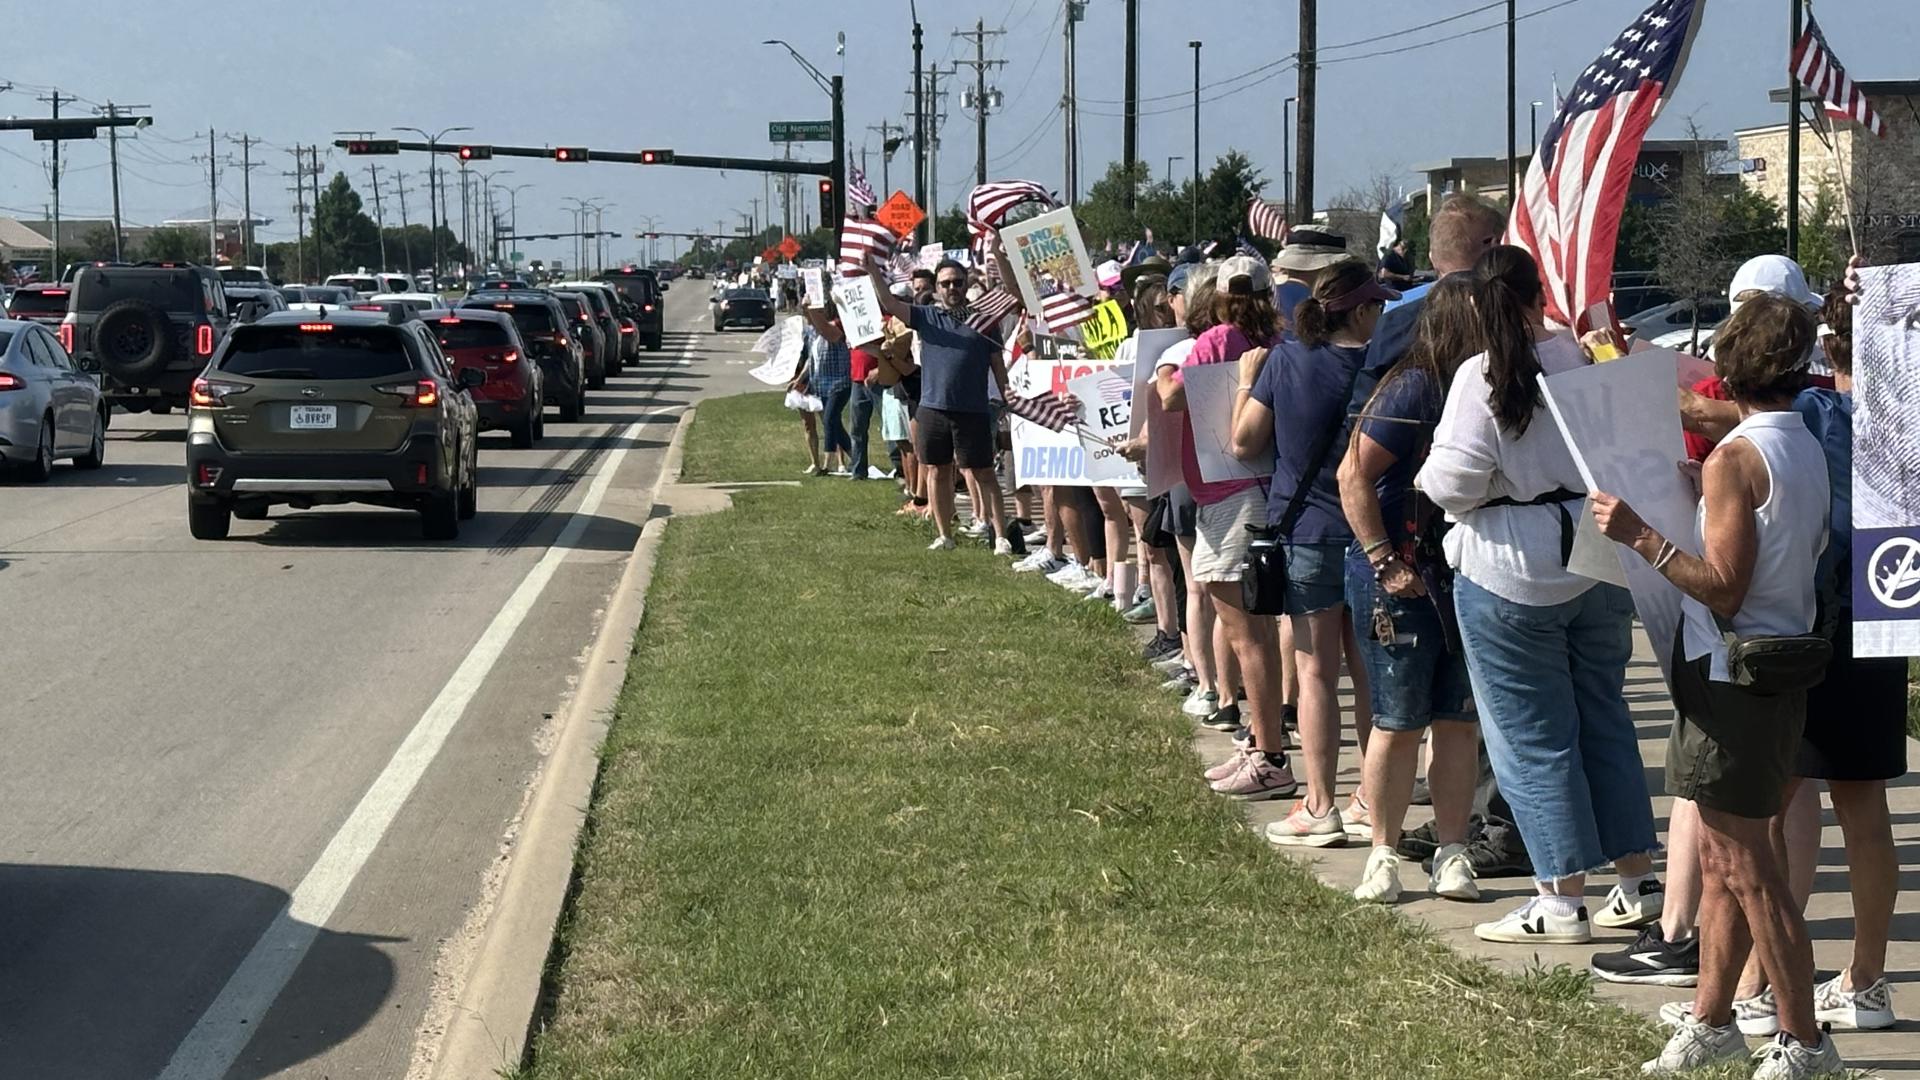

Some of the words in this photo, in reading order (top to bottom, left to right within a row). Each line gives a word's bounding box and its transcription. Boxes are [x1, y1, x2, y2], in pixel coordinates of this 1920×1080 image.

[771, 124, 787, 133] Old
[790, 124, 831, 133] Newman
[1029, 226, 1052, 245] NO
[1020, 234, 1071, 264] KINGS
[1020, 446, 1088, 480] DEMO
